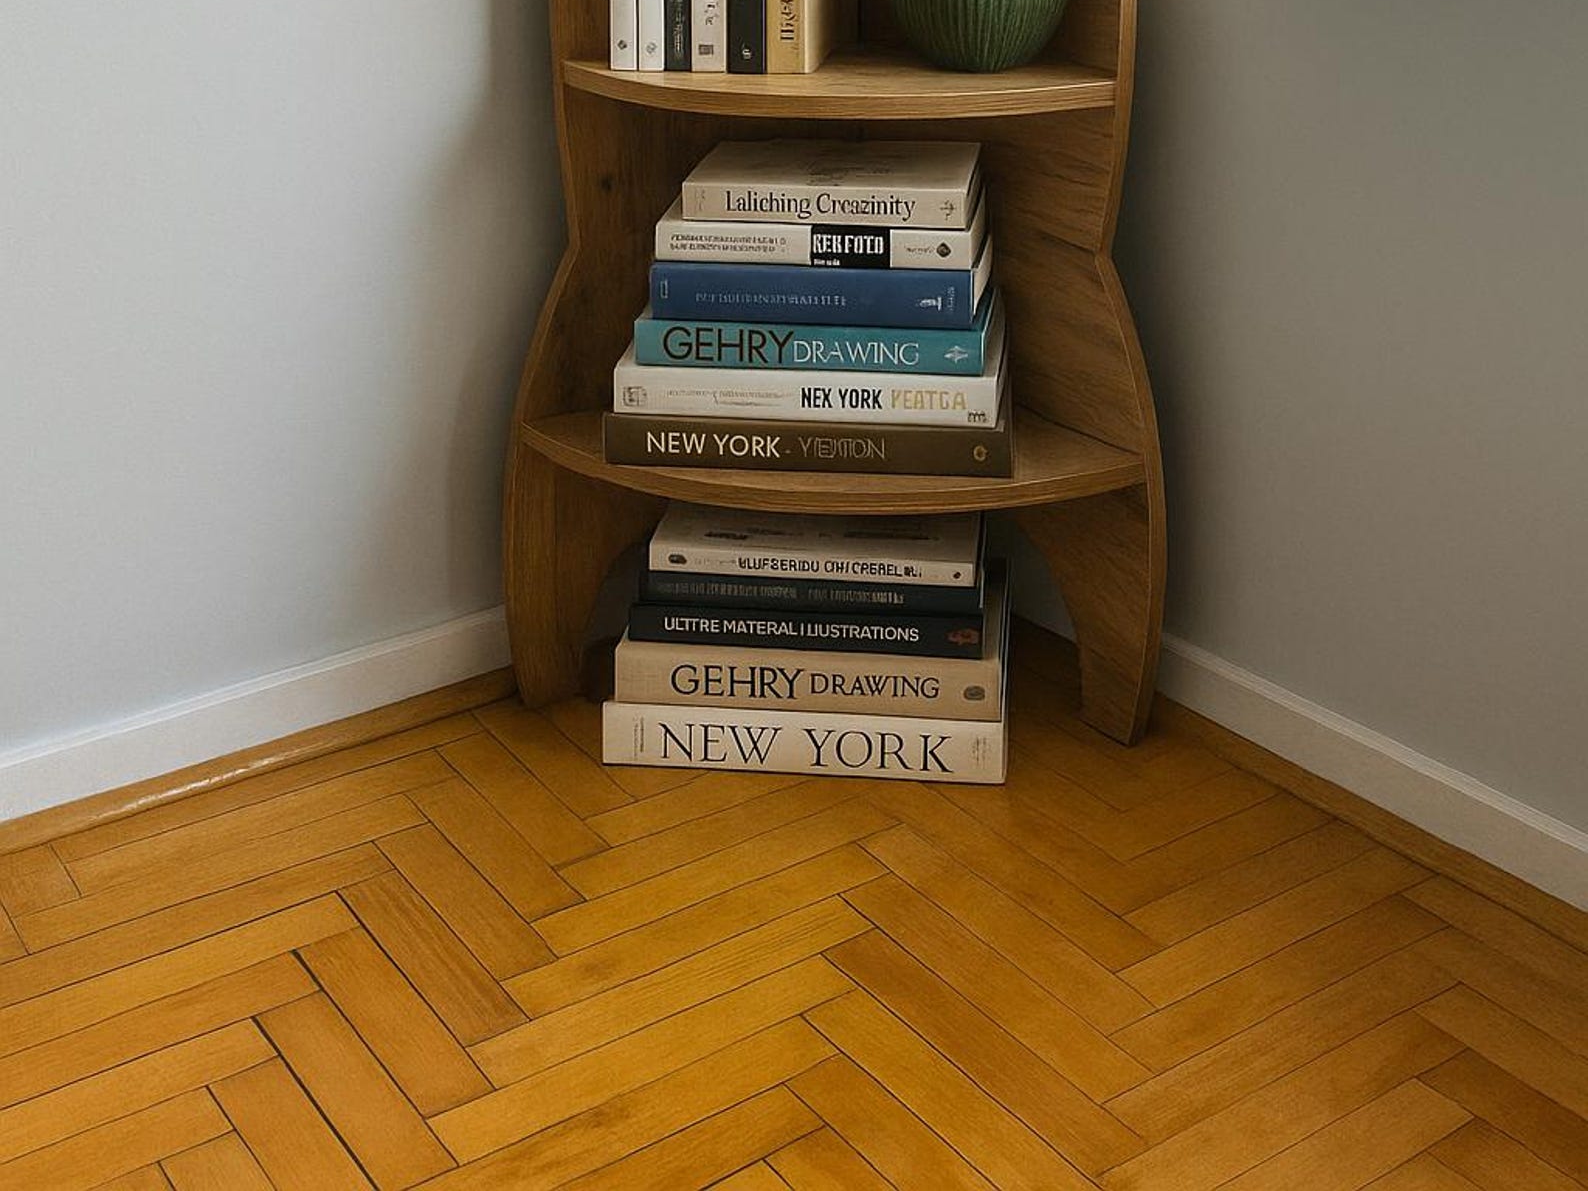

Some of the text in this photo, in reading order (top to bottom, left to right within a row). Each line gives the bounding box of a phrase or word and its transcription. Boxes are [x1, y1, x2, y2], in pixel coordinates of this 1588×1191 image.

[725, 190, 812, 219] Laliching
[663, 326, 919, 365] GEHRY DRAWING
[838, 388, 882, 410] YORK
[647, 431, 706, 454] NEW
[713, 434, 781, 458] YORK
[670, 664, 940, 699] GEHRY DRAWING
[658, 722, 782, 766] NEW
[802, 727, 954, 773] YORK
